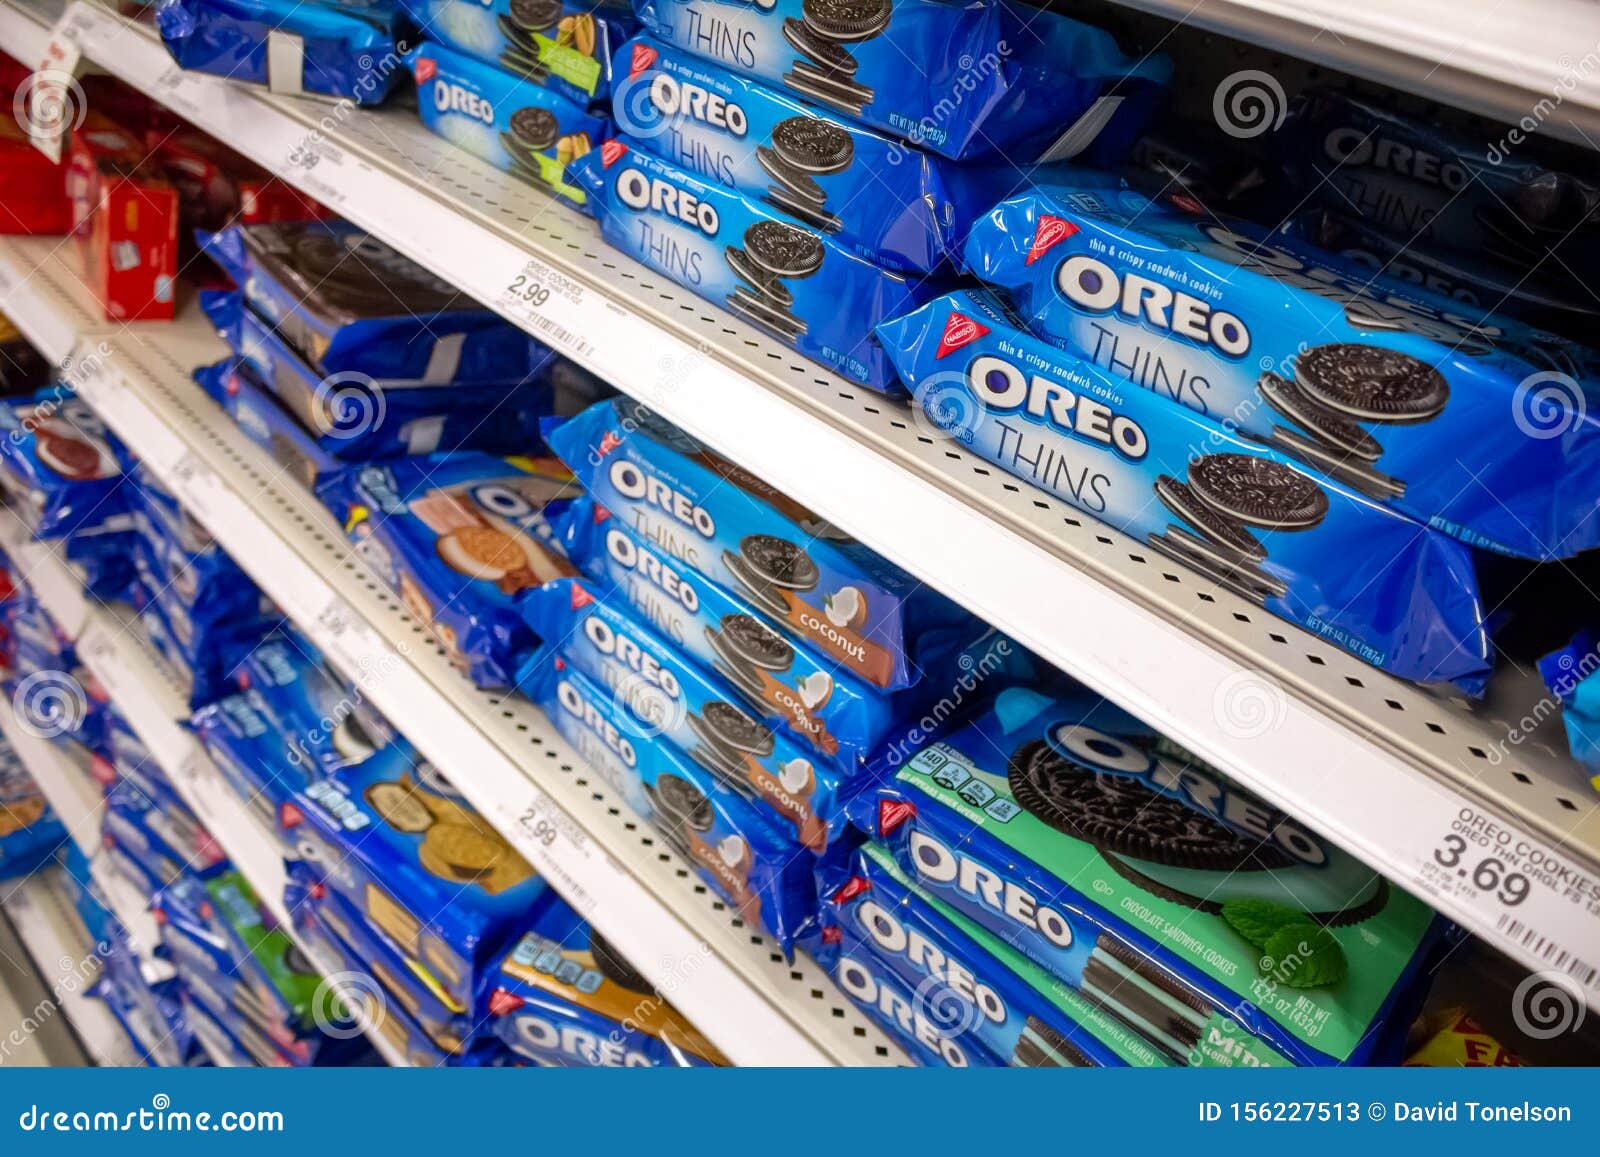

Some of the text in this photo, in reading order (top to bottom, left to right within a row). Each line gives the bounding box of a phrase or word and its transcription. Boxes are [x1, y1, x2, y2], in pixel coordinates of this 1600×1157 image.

[686, 8, 756, 68] THINS
[434, 79, 494, 124] OREO
[650, 73, 747, 137] OREO
[668, 127, 736, 188] THINS
[1325, 128, 1468, 192] OREO
[616, 168, 719, 235] OREO
[1343, 177, 1440, 237] THINS
[638, 219, 702, 286] THINS
[1089, 239, 1224, 300] thin & crispy sandwich cookies
[508, 275, 550, 307] 2.99
[1058, 256, 1250, 356] OREO
[998, 341, 1124, 406] thin & crispy sandwich cookies
[1091, 322, 1211, 415] THINS
[969, 355, 1147, 458] OREO
[610, 460, 716, 538] OREO
[995, 419, 1112, 513] THINS
[606, 529, 699, 613] OREO
[632, 507, 701, 568] THINS
[625, 576, 686, 646] THINS
[800, 612, 867, 663] coconut
[1306, 615, 1320, 630] NET
[585, 615, 681, 698] OREO
[557, 680, 637, 767] OREO
[922, 750, 941, 765] 140
[519, 808, 557, 846] 2.99
[1056, 724, 1326, 866] OREO
[1434, 834, 1530, 907] 3.69
[1451, 820, 1489, 847] OREO
[1492, 844, 1520, 866] THN
[1458, 808, 1512, 845] OREO
[1515, 841, 1600, 902] COOKIES
[910, 829, 1073, 947] OREO
[859, 901, 1006, 1023] OREO
[1120, 897, 1238, 976] CHOCOLATE SANDWICH COOKIES
[839, 956, 968, 1067] OREO
[1275, 998, 1291, 1015] OZ
[1288, 1007, 1325, 1039] (432g)
[1295, 995, 1333, 1024] NET WT
